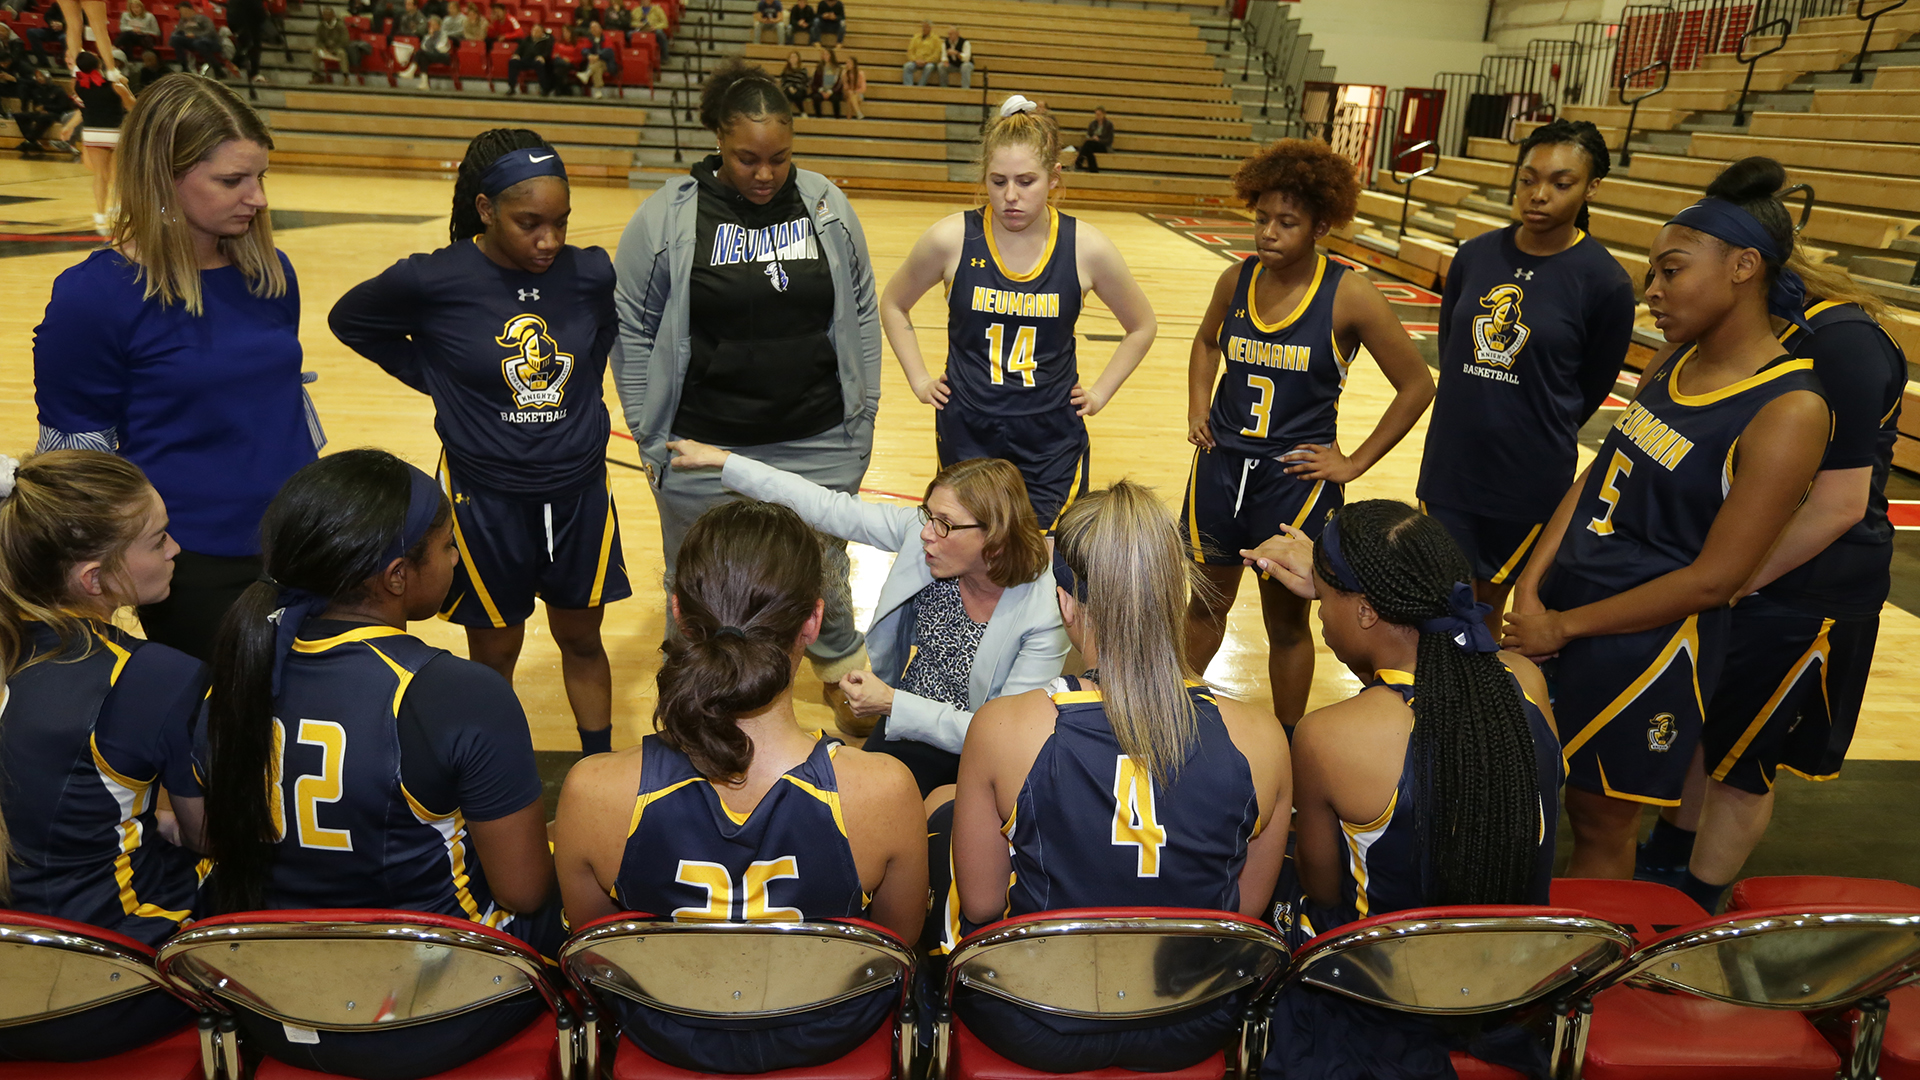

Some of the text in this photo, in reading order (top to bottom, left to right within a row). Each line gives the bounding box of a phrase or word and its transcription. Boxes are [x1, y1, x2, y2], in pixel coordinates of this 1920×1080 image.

[710, 217, 818, 266] NEUMANN
[972, 286, 1060, 317] NEUMANN
[985, 323, 1037, 387] 14
[1228, 335, 1311, 372] NEUMANN
[1463, 363, 1520, 385] BASKETBALL
[500, 409, 567, 423] BASKETBALL
[521, 393, 557, 402] KNIGHTS
[1240, 374, 1275, 438] 3
[1613, 400, 1695, 472] EUMANN
[1586, 447, 1634, 536] 5
[1111, 754, 1167, 878] 4
